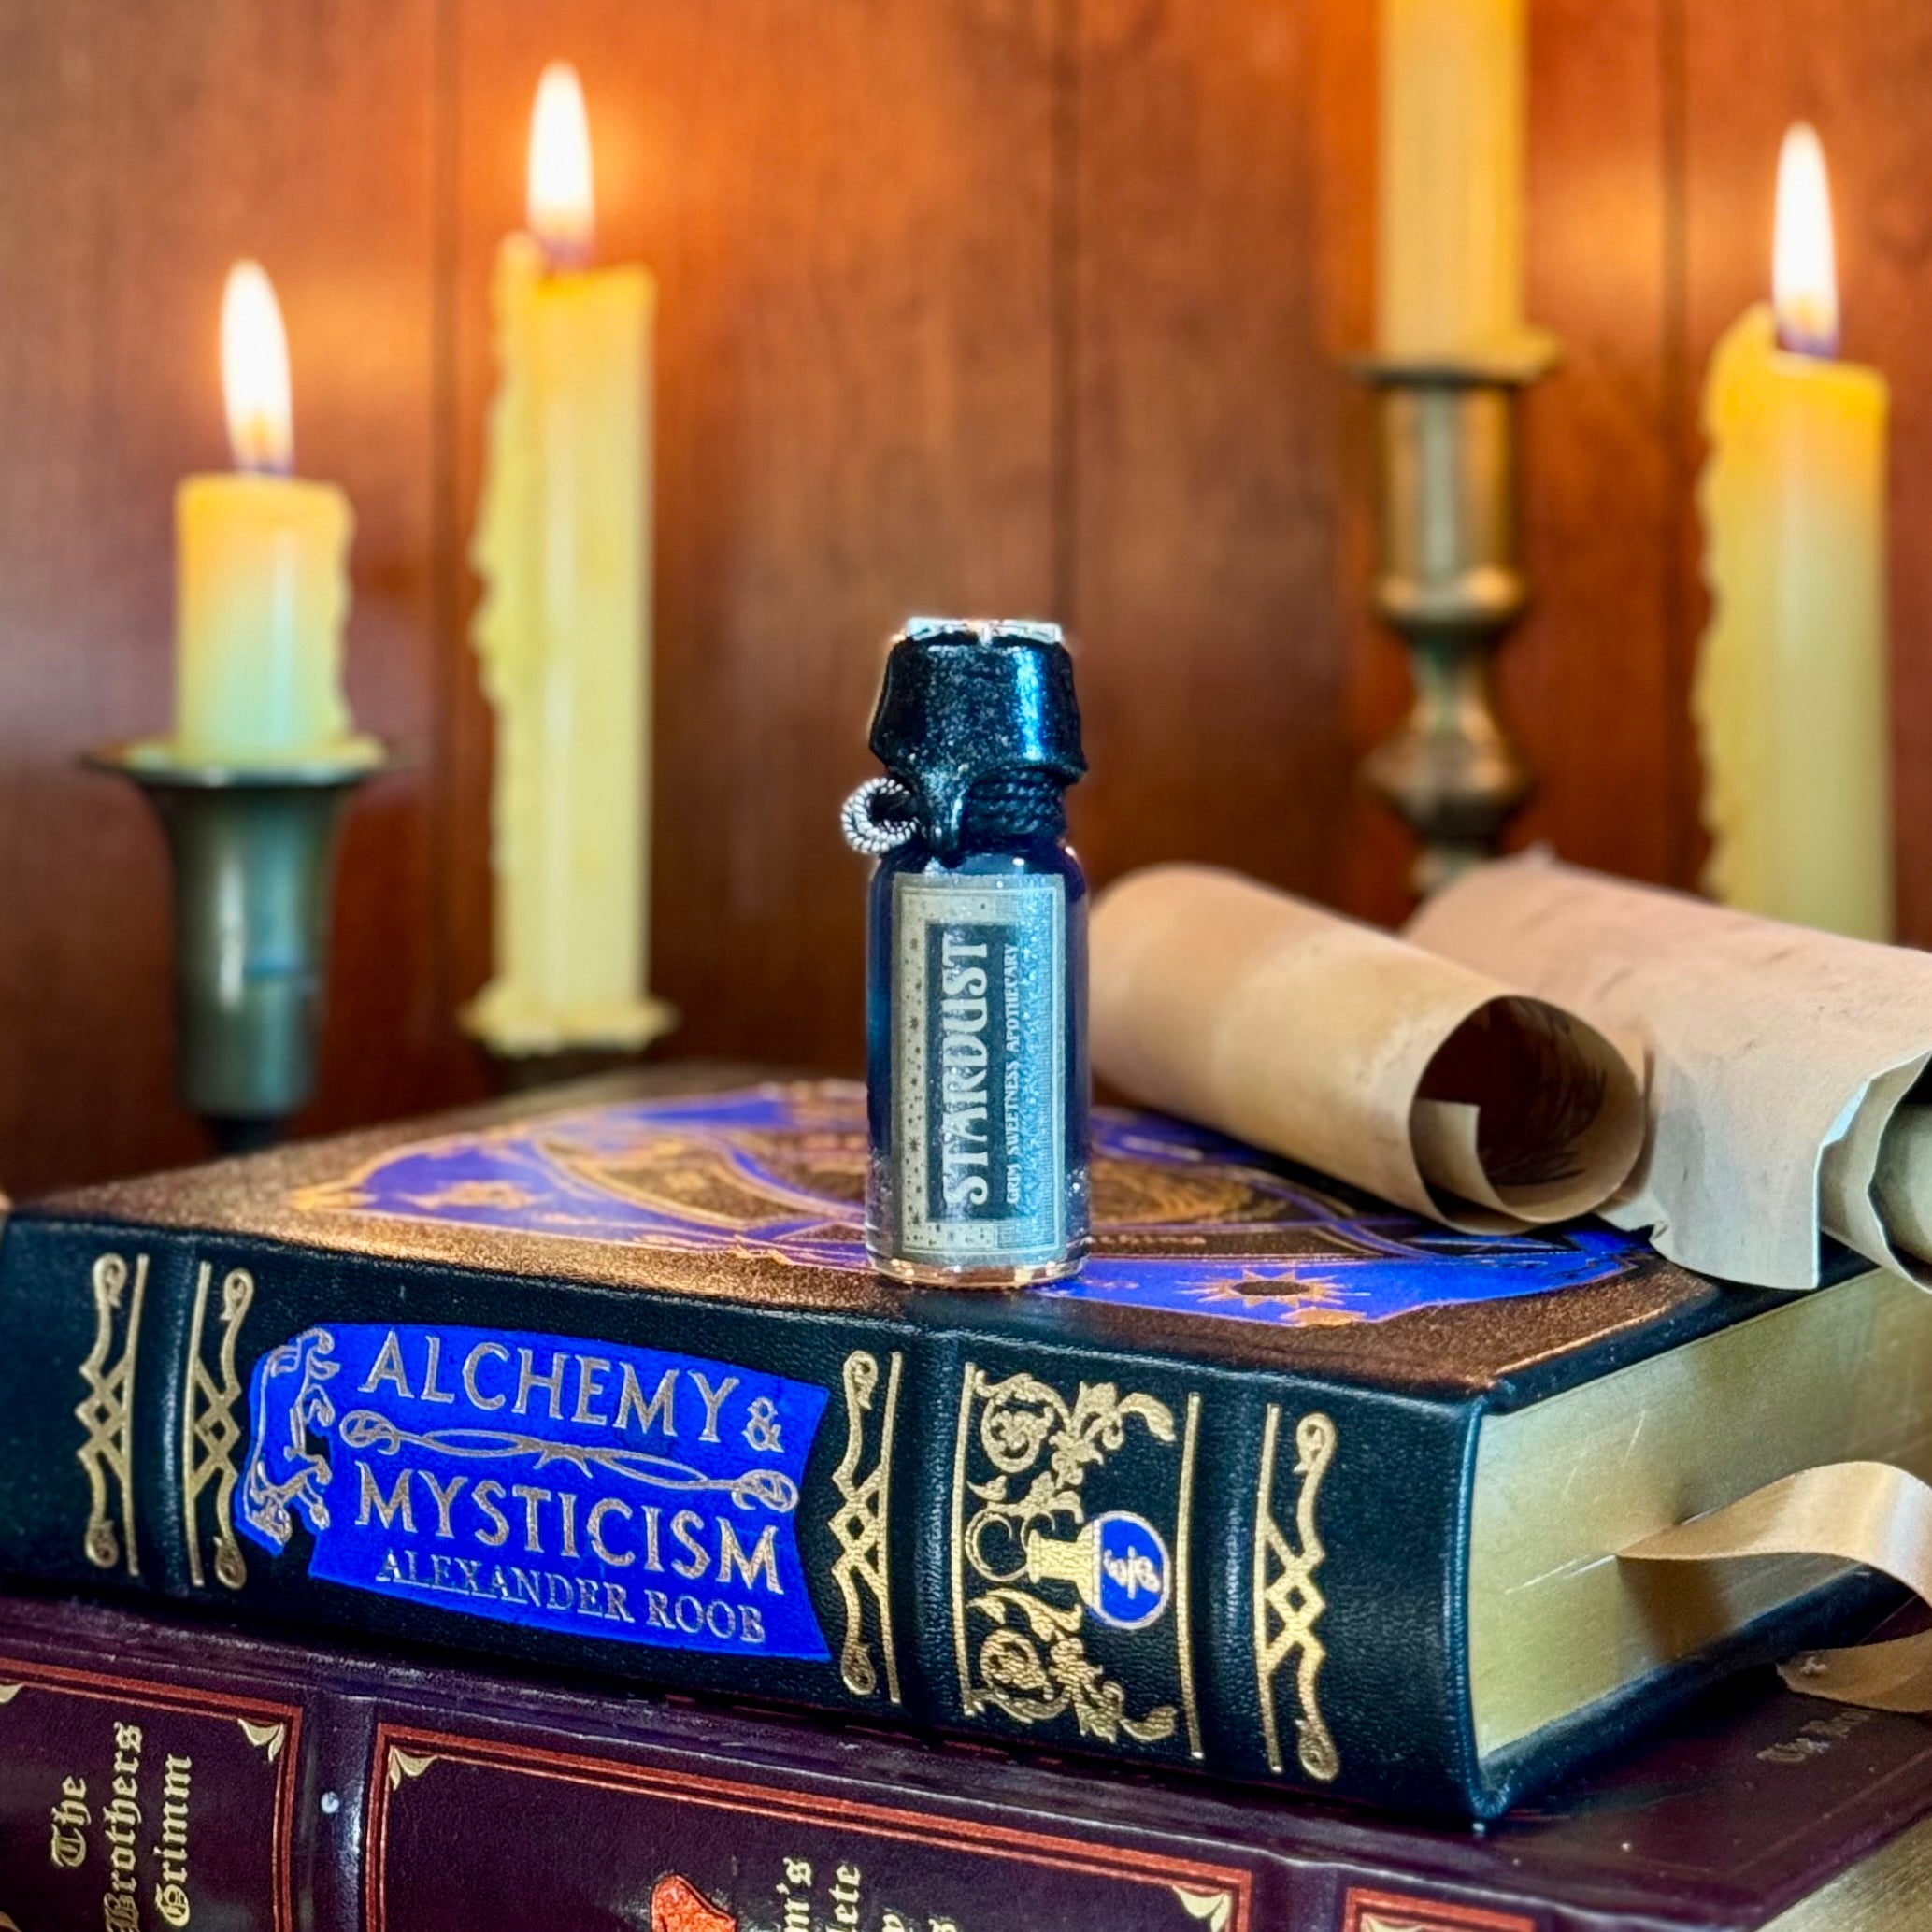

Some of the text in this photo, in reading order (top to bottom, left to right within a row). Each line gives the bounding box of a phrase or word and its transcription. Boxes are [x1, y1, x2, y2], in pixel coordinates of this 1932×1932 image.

[942, 931, 988, 1206] STARDUST
[1002, 942, 1022, 1205] GRIM SWEETNESS APOTHECARY
[358, 1329, 785, 1453] ALCHEMY &
[354, 1461, 785, 1595] MYSTICISM
[376, 1548, 766, 1644] ALEXANDER ROOB
[51, 1775, 91, 1868] The
[153, 1753, 192, 1928] Grimm
